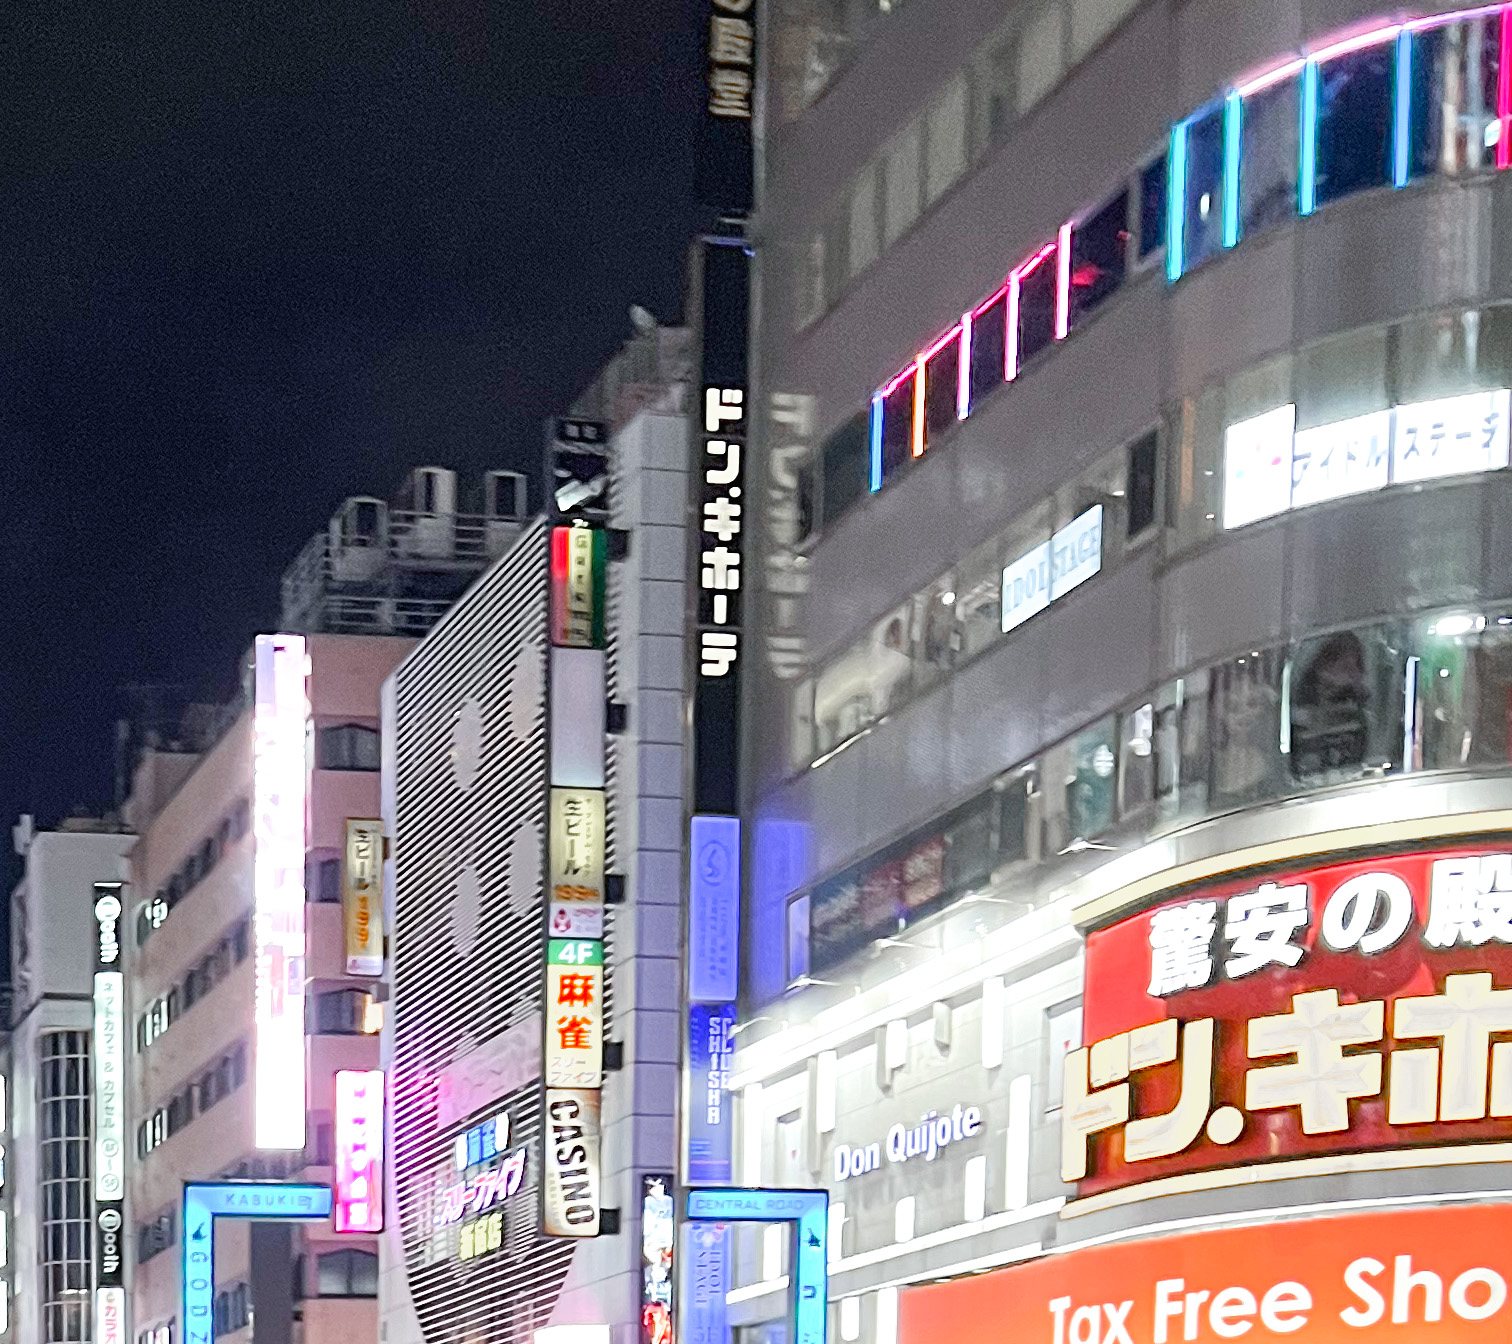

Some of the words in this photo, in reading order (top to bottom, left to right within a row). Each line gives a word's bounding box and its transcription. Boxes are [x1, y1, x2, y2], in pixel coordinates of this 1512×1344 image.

[558, 942, 593, 965] 4F
[557, 973, 594, 1050] 麻雀
[550, 1099, 596, 1226] CASINO
[834, 1142, 881, 1182] Don
[886, 1104, 982, 1163] Quijote
[696, 1199, 761, 1210] CENTRAL
[1153, 1278, 1312, 1344] Free
[1339, 1254, 1507, 1328] Sho
